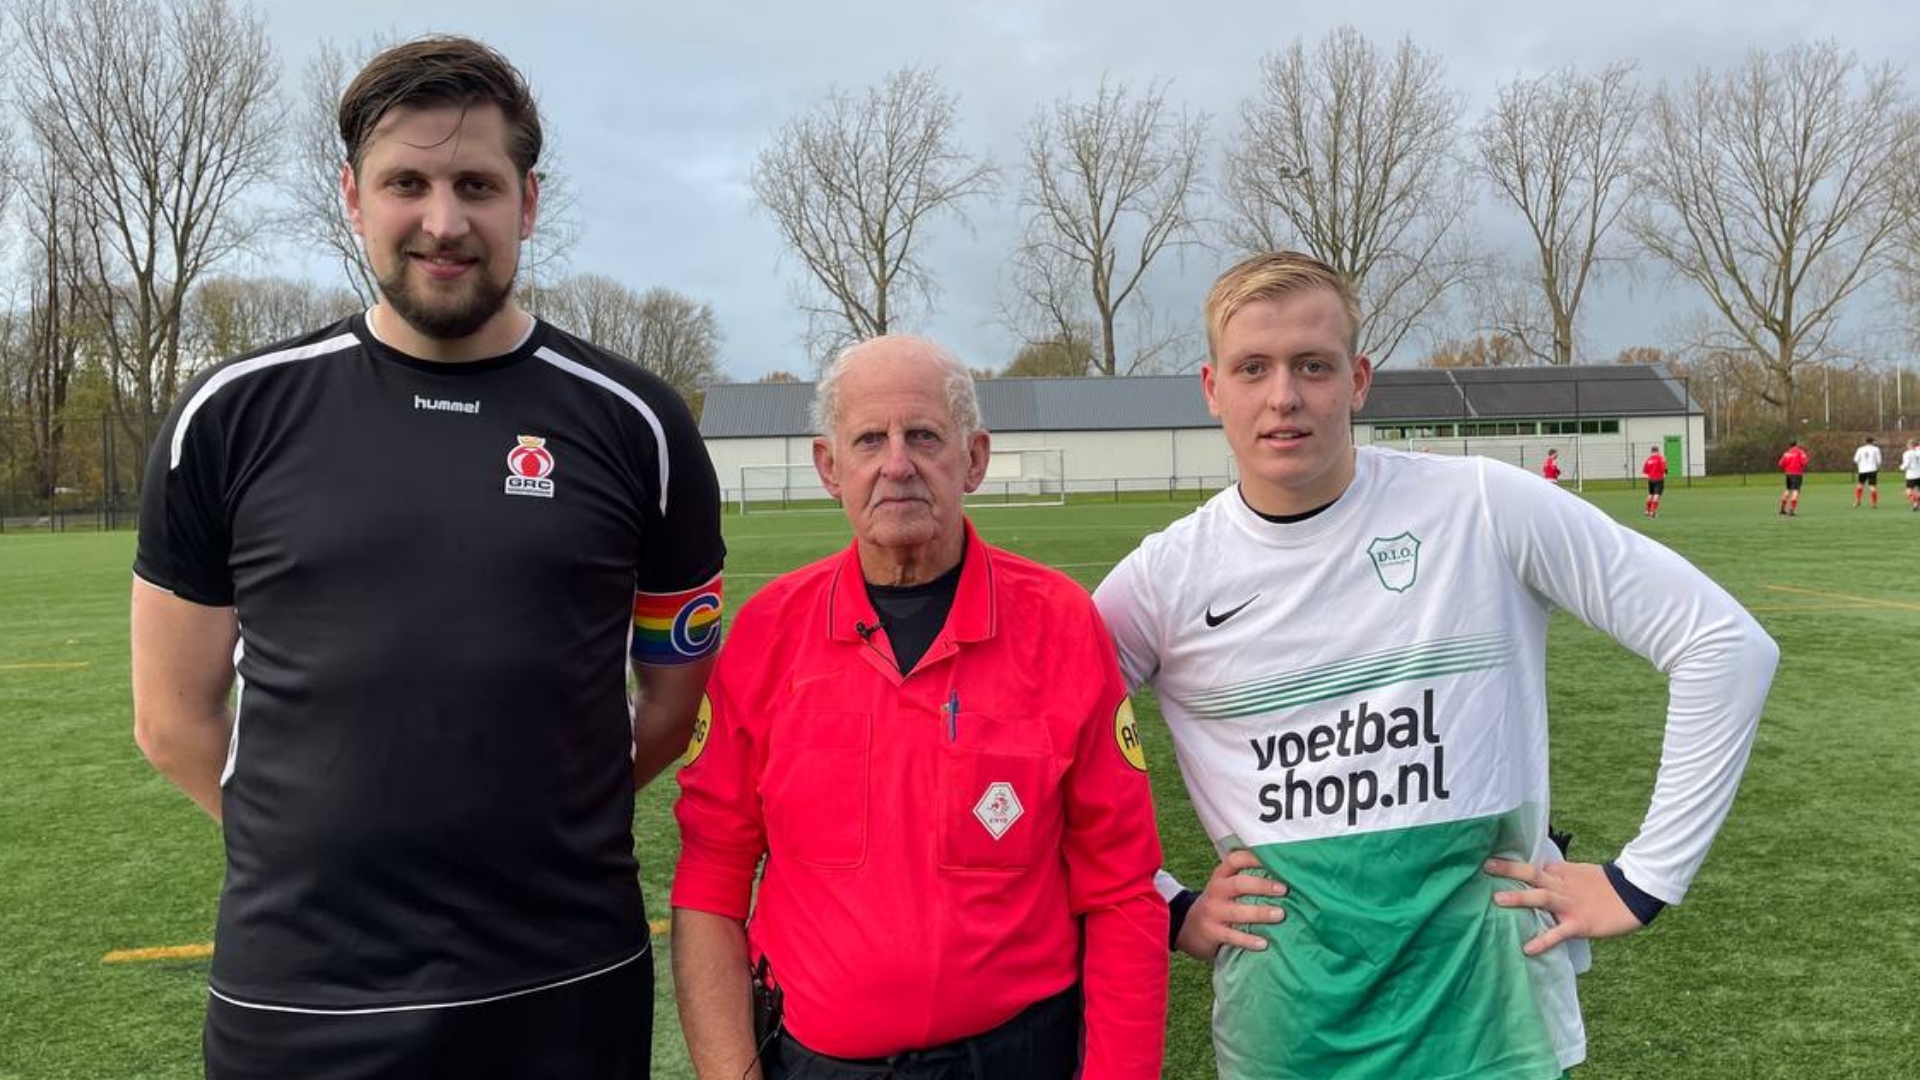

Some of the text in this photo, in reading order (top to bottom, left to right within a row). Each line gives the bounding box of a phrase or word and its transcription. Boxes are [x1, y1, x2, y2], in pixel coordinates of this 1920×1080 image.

[414, 394, 481, 414] hummel
[1378, 547, 1415, 563] D.I.O.
[670, 592, 722, 656] C
[1250, 689, 1440, 771] voetbal
[1258, 745, 1450, 826] shop.nl
